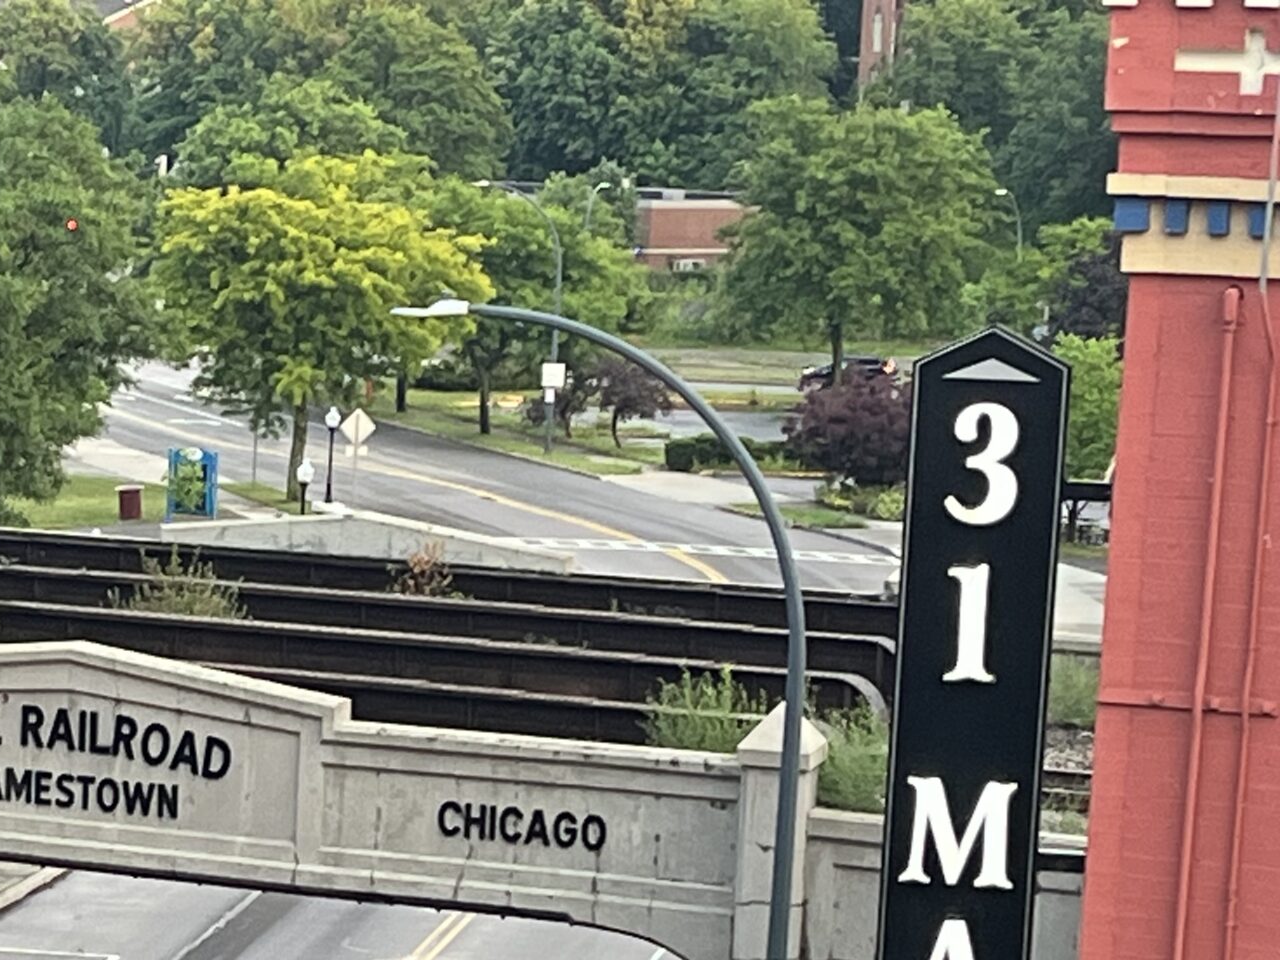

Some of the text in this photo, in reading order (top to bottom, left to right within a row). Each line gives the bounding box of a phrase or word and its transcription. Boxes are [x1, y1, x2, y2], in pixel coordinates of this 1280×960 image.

[943, 403, 1018, 682] 31
[21, 705, 231, 781] RAILROAD
[439, 801, 606, 853] CHICAGO
